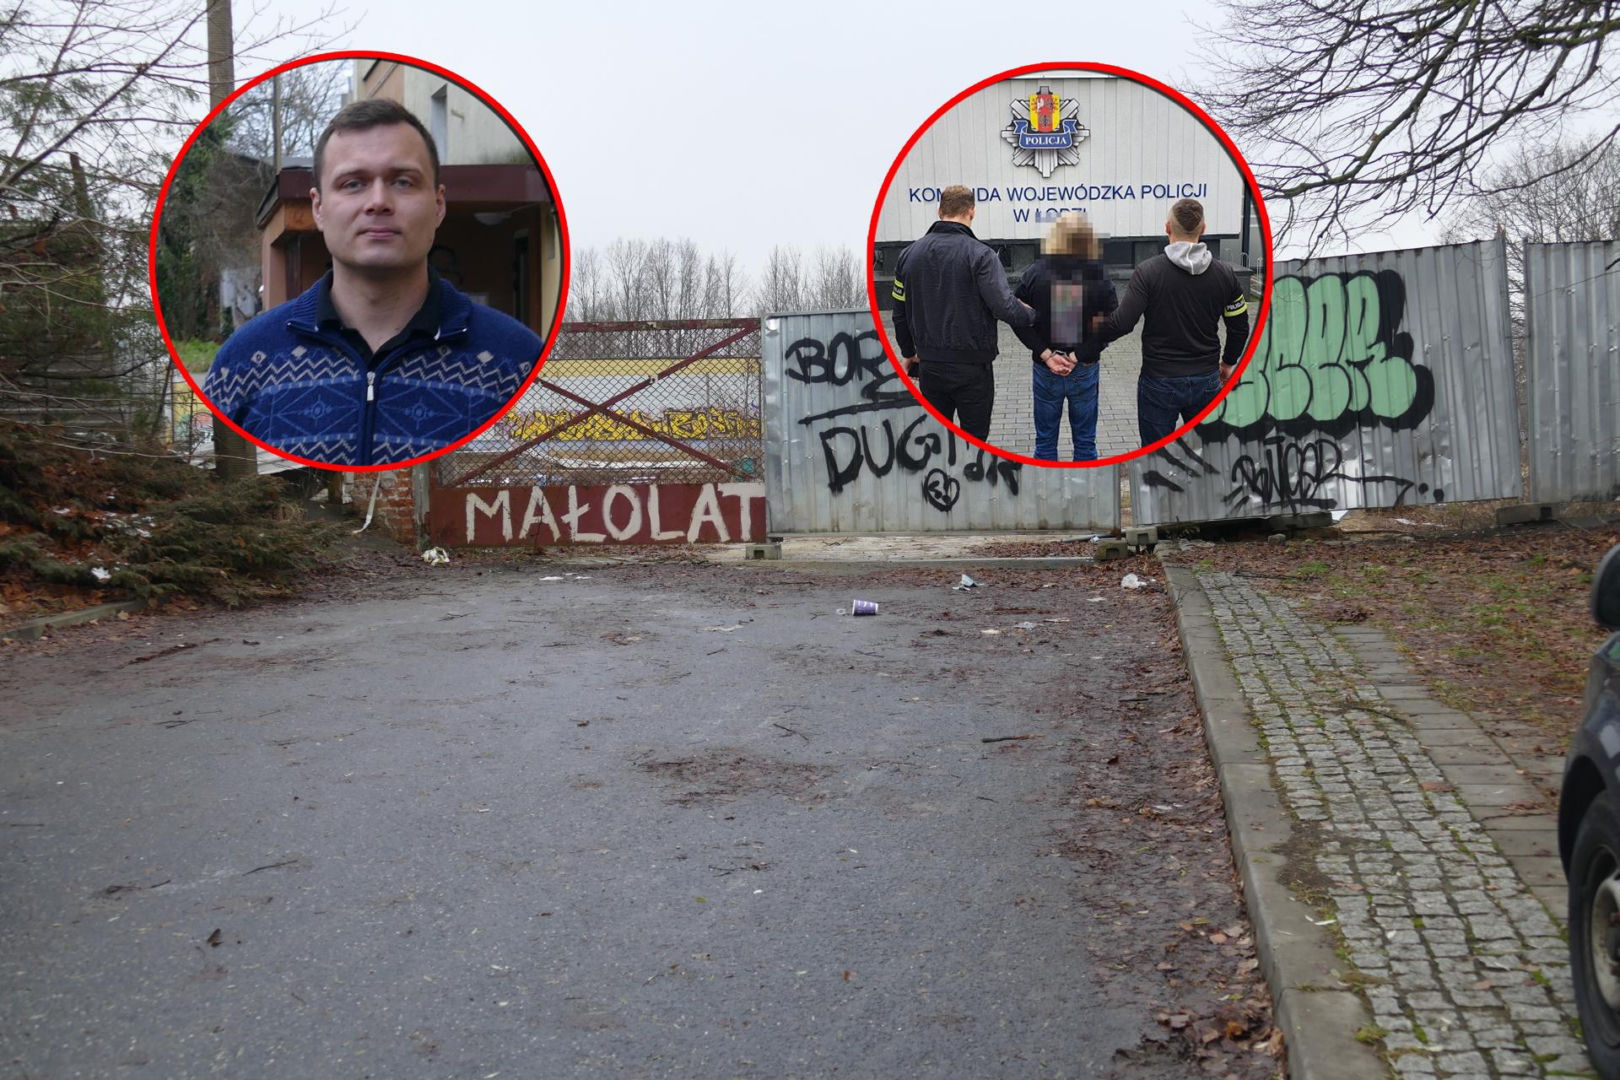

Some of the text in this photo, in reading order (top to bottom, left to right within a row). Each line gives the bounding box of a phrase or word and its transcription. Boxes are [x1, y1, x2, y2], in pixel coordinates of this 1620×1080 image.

[1025, 136, 1067, 145] POLICJA
[909, 183, 1207, 202] KODA WOJEWÓDZKA POLICJI
[1013, 208, 1030, 223] W
[465, 482, 767, 544] MAŁOLAT
